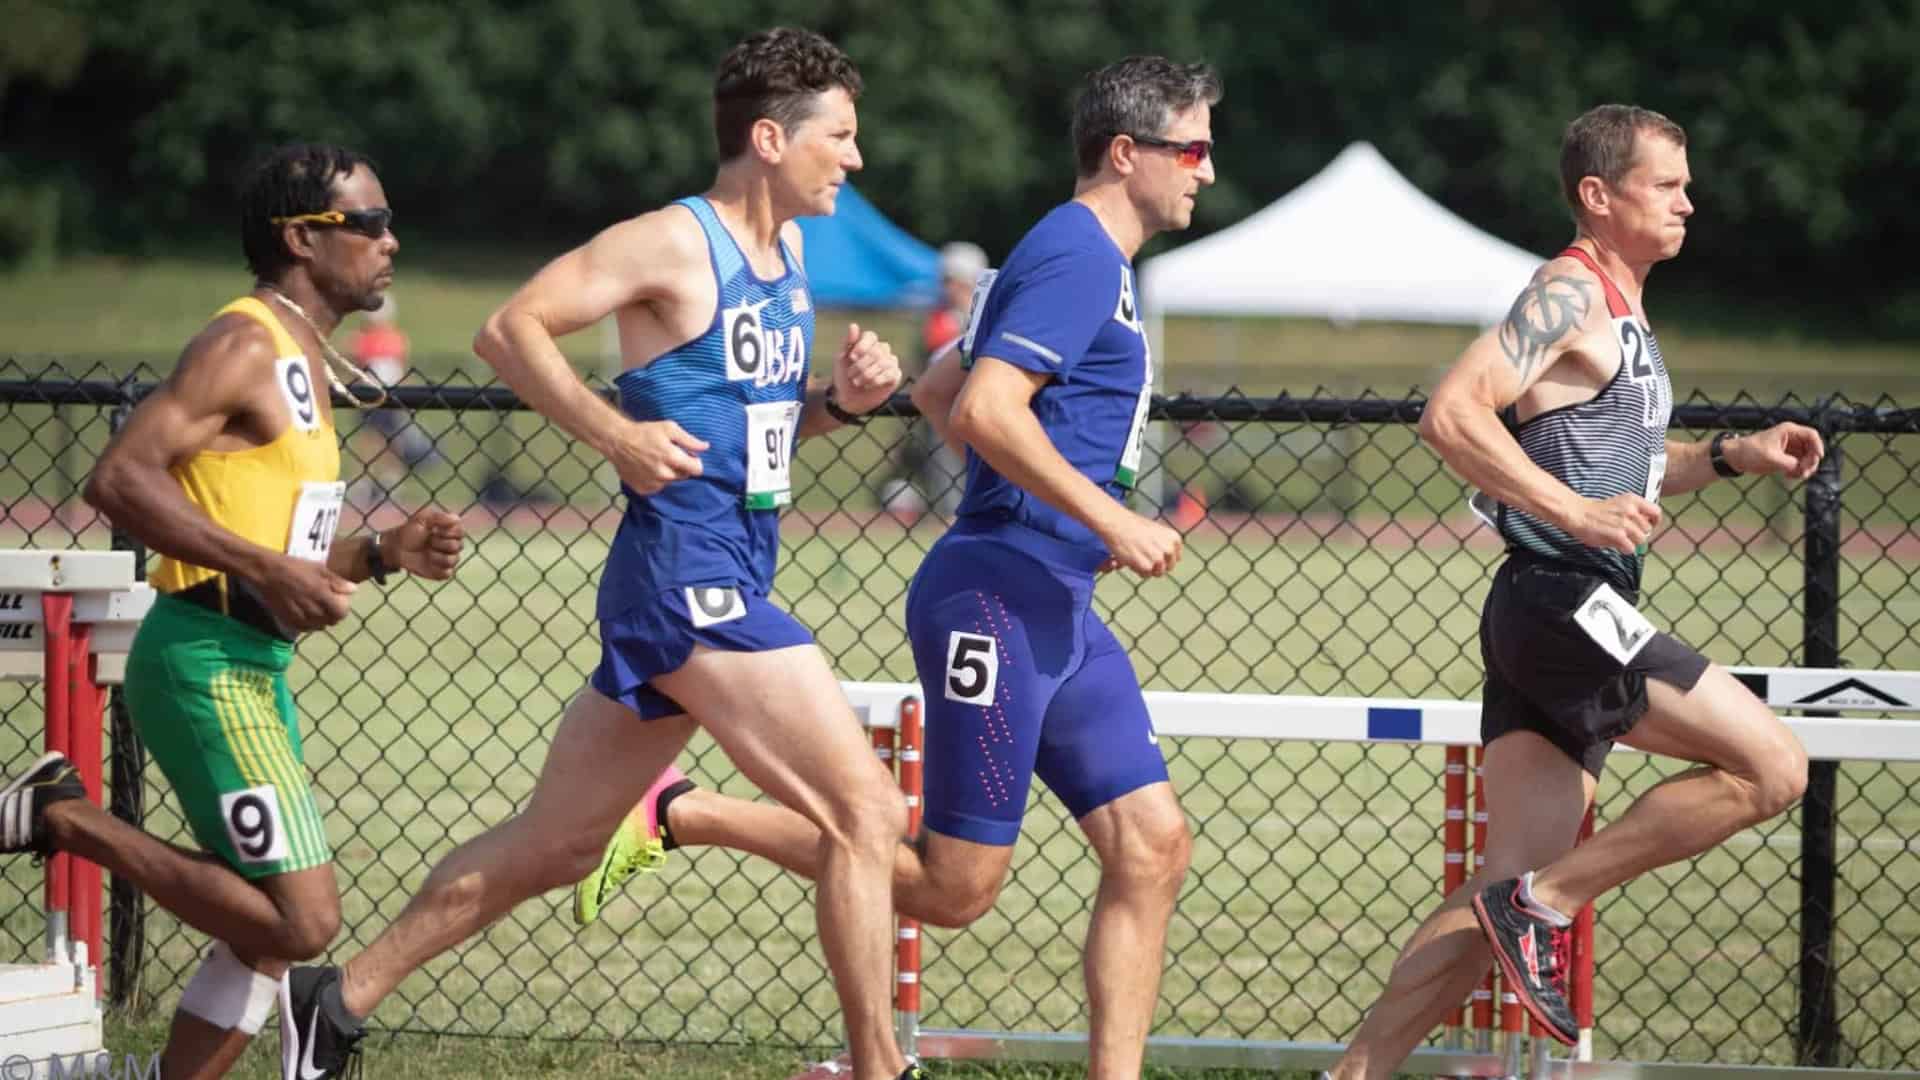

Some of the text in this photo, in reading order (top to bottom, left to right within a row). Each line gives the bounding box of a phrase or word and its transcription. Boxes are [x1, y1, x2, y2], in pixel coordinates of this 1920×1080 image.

[731, 312, 761, 374] 6
[1621, 320, 1653, 378] 2
[286, 362, 314, 424] 9
[1587, 599, 1650, 654] 2
[948, 636, 992, 698] 5
[231, 793, 274, 858] 9
